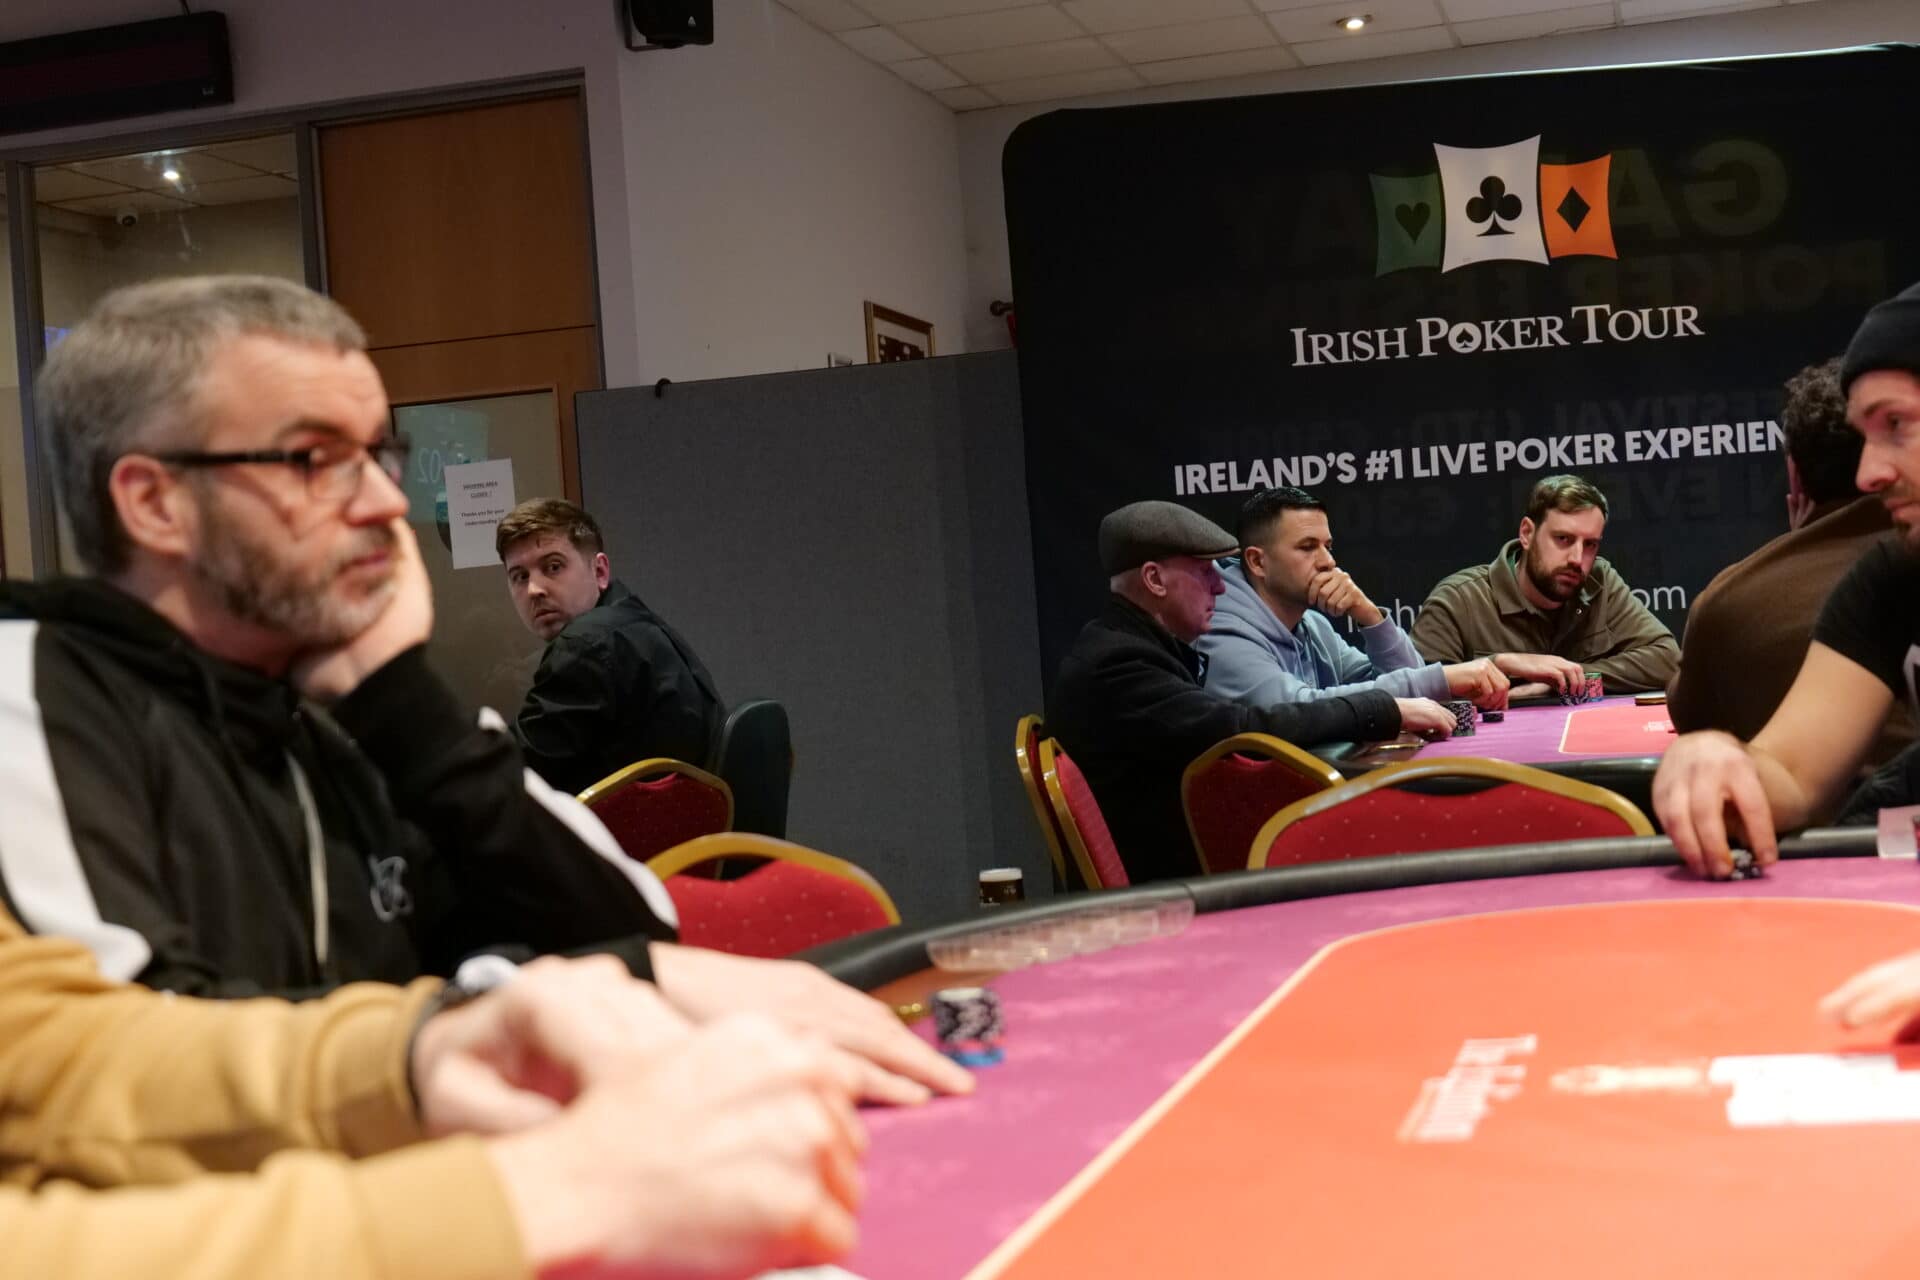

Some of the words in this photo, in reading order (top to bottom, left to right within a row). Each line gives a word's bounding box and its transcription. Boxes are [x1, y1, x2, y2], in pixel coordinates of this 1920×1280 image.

[1290, 327, 1409, 366] IRISH
[1416, 315, 1570, 358] POKER
[1572, 303, 1705, 344] TOUR
[1174, 452, 1358, 496] IRELAND'S
[1364, 449, 1404, 481] #1
[1411, 442, 1488, 478] LIVE
[1495, 433, 1619, 472] POKER
[1625, 420, 1786, 462] EXPERIEN
